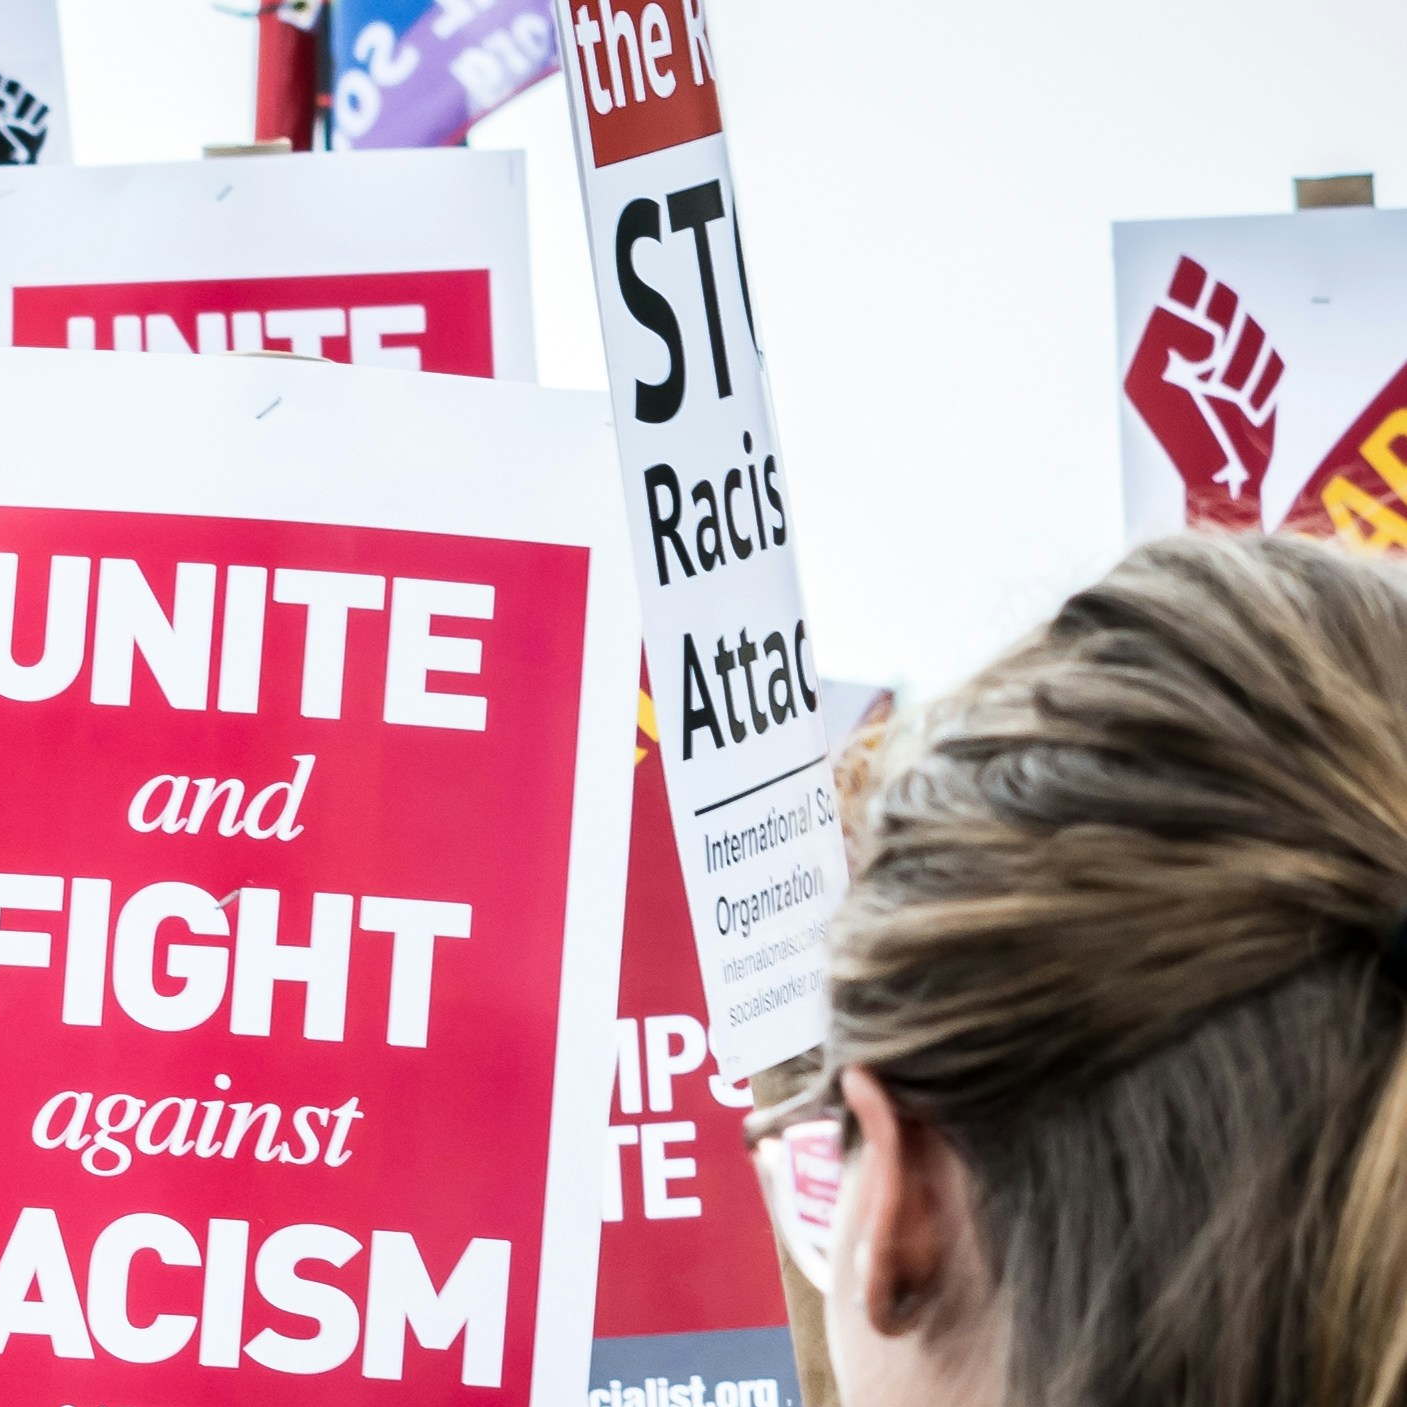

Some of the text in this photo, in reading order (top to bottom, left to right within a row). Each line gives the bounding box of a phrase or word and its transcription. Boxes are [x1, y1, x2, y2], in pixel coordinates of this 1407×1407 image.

[615, 179, 763, 424] ST
[127, 753, 316, 843] and
[704, 791, 812, 874] International
[715, 863, 825, 938] Organization
[31, 1073, 365, 1178] against
